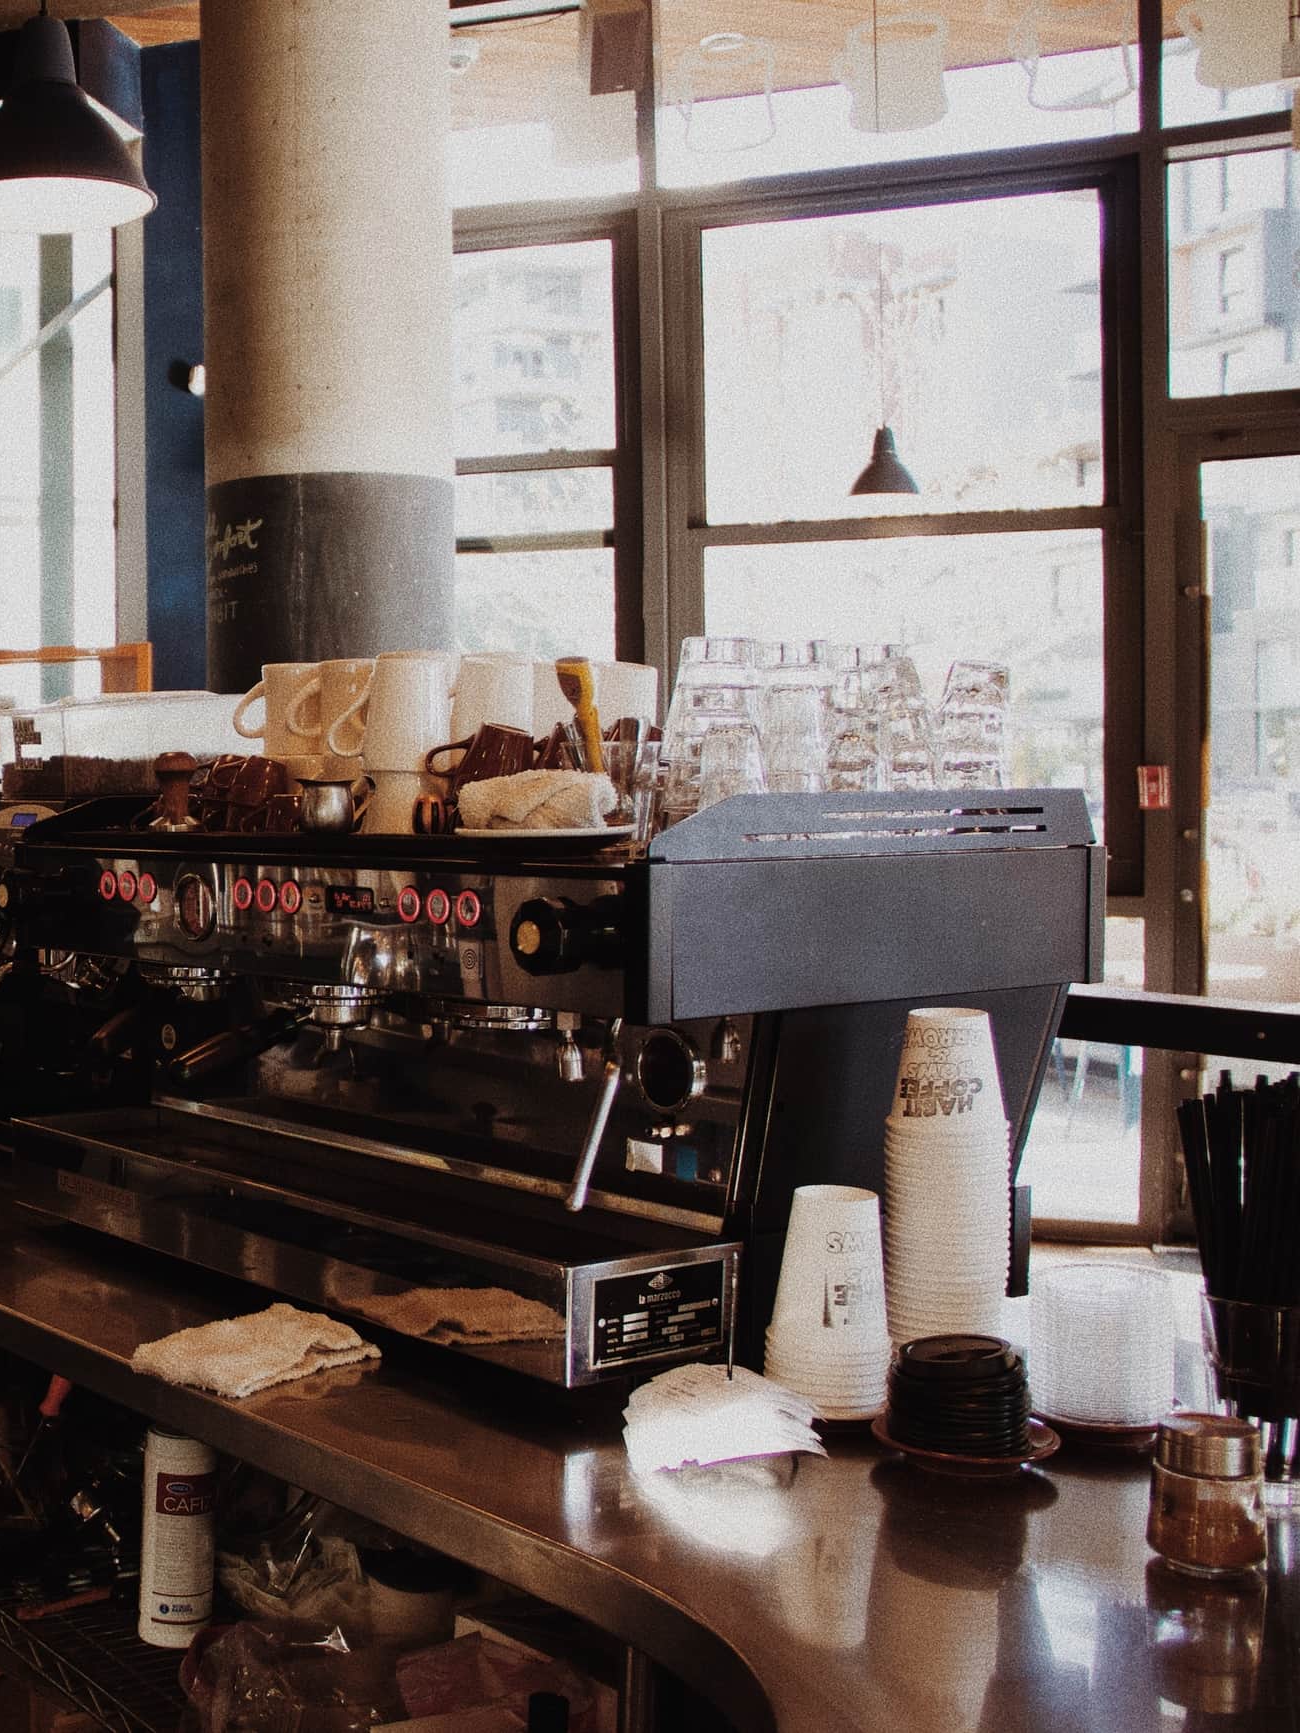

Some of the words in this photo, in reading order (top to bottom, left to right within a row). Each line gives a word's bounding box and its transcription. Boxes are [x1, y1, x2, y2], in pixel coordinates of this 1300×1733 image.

[899, 1077, 983, 1099] COFFEE
[902, 1094, 975, 1118] HABIT
[638, 1294, 646, 1304] la
[647, 1290, 682, 1303] marzocco
